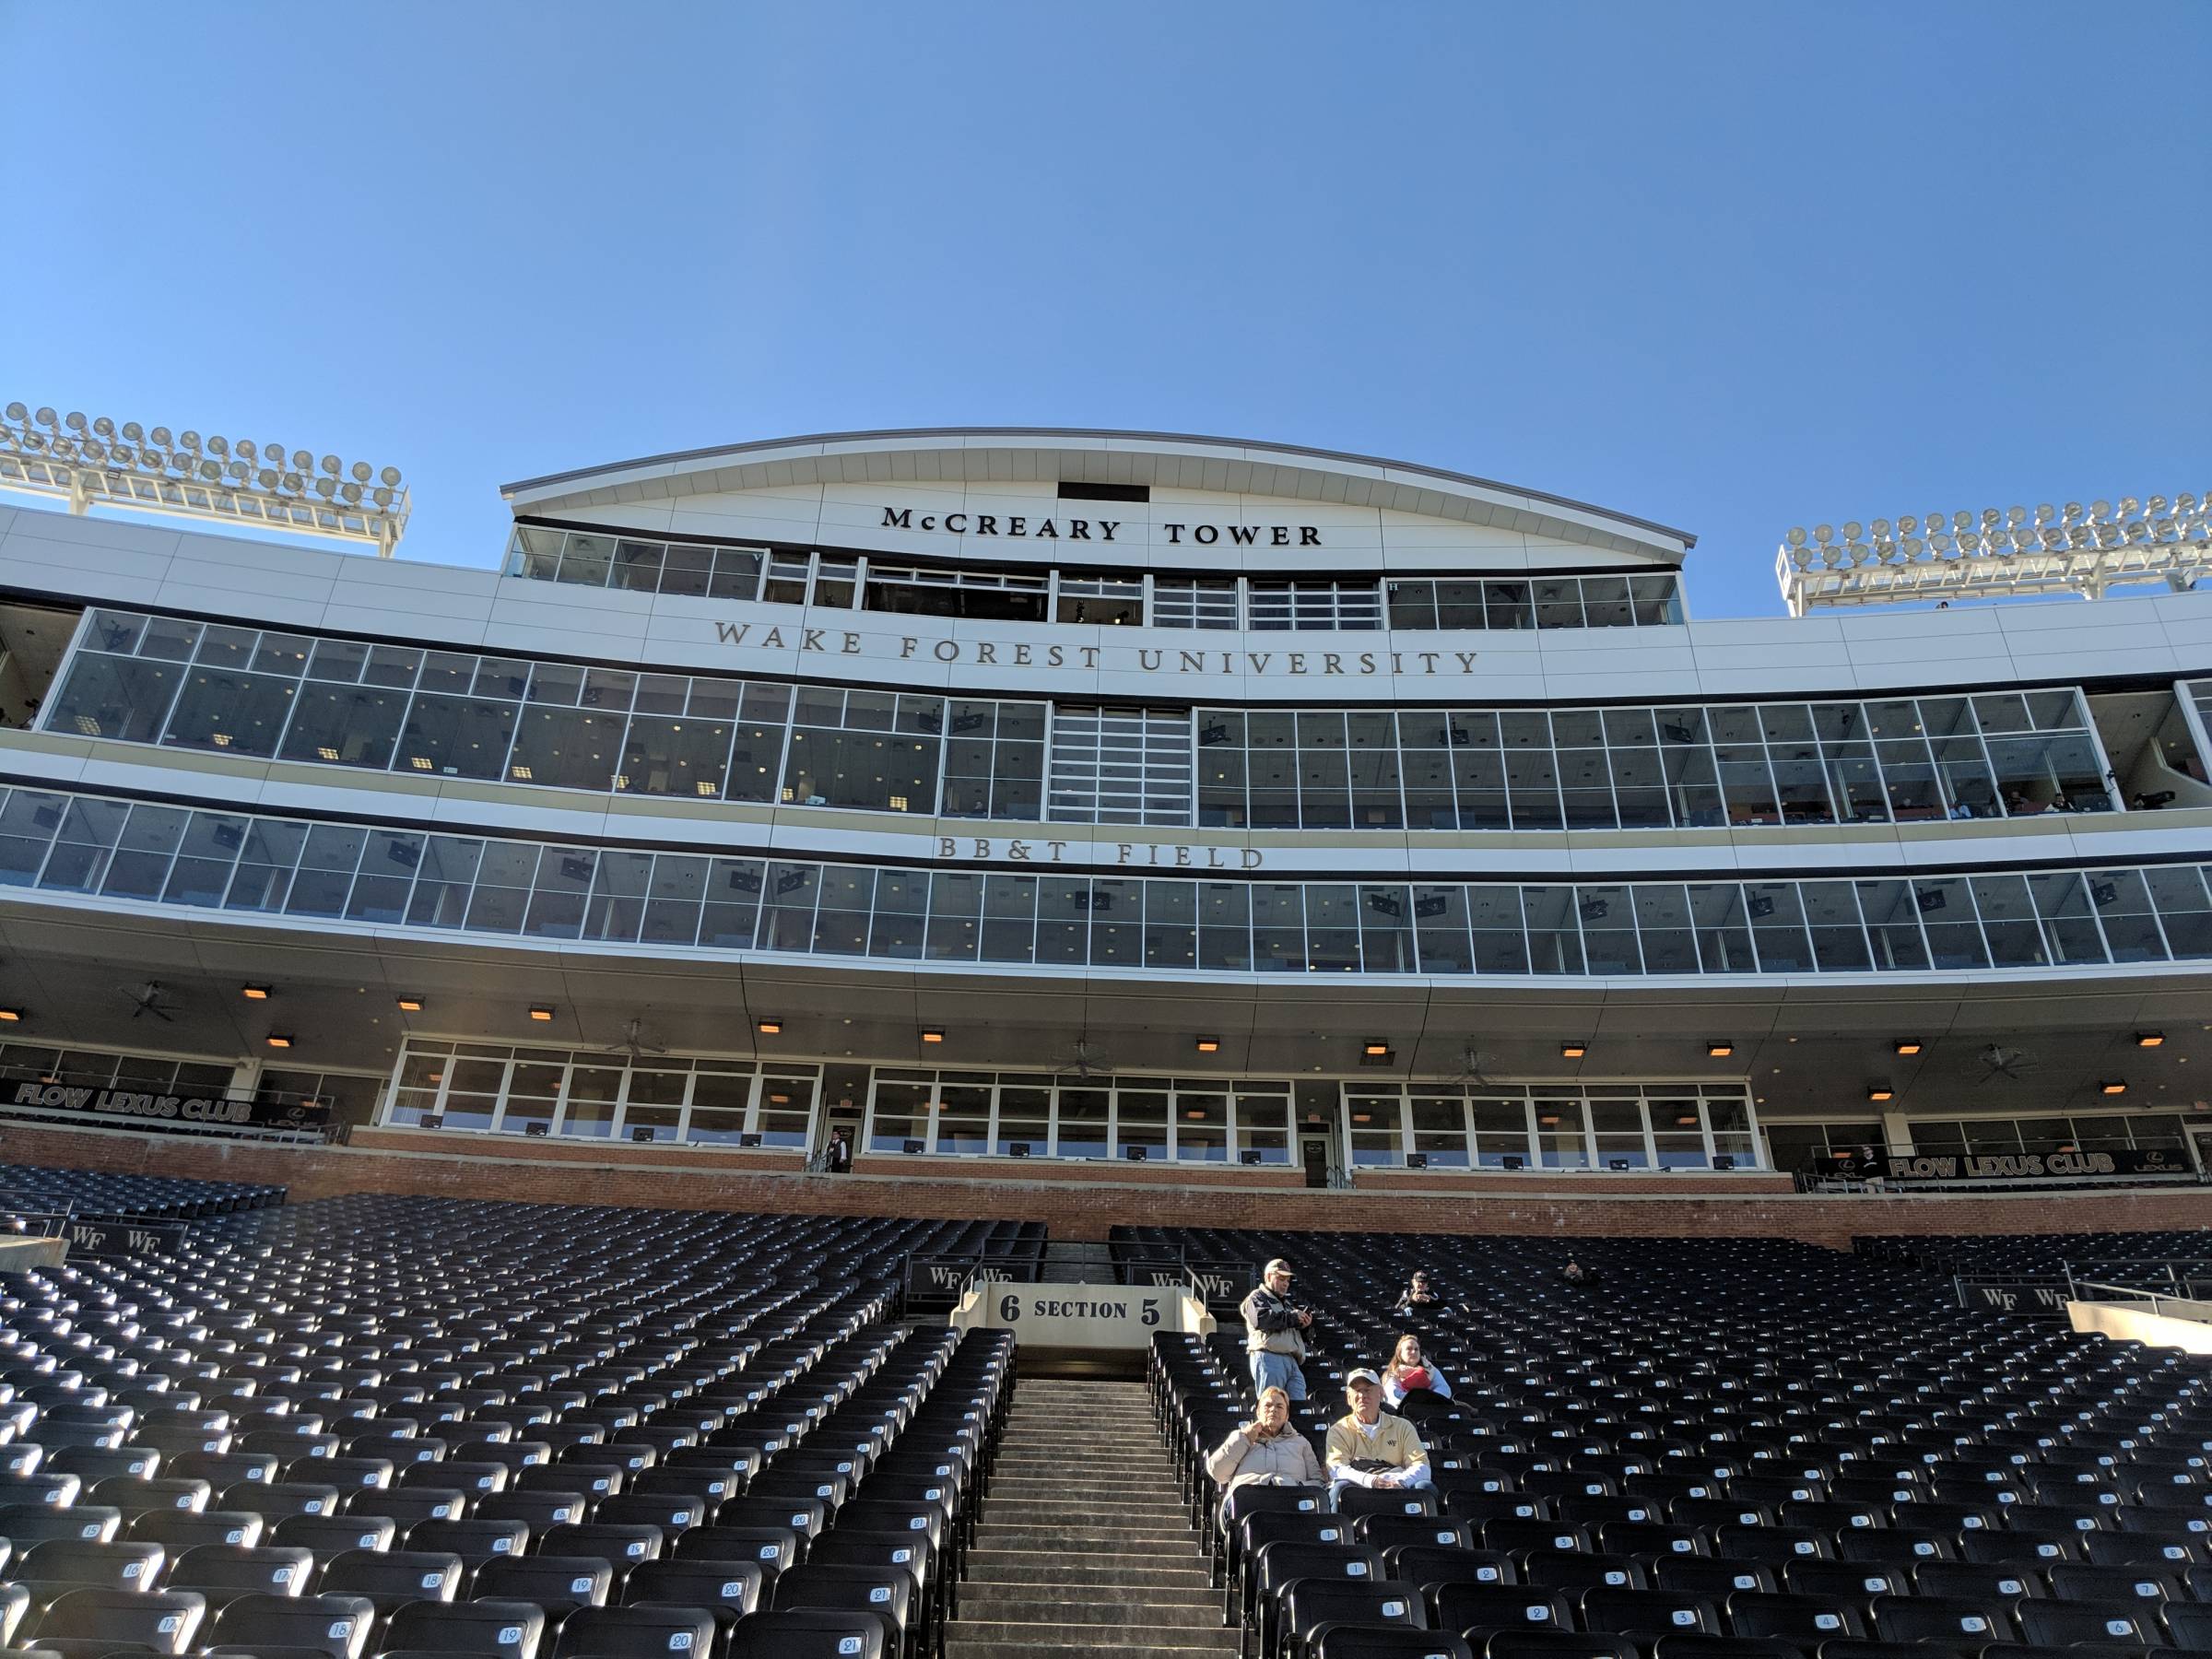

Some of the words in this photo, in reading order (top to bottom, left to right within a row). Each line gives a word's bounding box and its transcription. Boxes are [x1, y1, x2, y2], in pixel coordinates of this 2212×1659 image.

[881, 506, 1122, 542] McCREARY
[1164, 523, 1324, 546] TOWER
[714, 621, 862, 654] WAKE
[900, 636, 1102, 669] FOREST
[1139, 649, 1479, 675] UNIVERSITY
[939, 837, 1067, 862] BB&T
[1117, 843, 1264, 869] FIELD
[15, 1083, 92, 1108] FLOW
[94, 1090, 181, 1117] LEXUS
[182, 1099, 253, 1123] CLUB
[1888, 1159, 1957, 1178] FLOW
[1963, 1155, 2044, 1176] LEXUS
[2047, 1153, 2116, 1173] CLUB
[74, 1225, 106, 1251] WF
[128, 1230, 161, 1254] WF
[930, 1266, 961, 1289] WF
[1202, 1275, 1233, 1298] WF
[1982, 1288, 2018, 1311] WF
[2034, 1288, 2070, 1311] WF
[1000, 1295, 1020, 1322] 6
[1034, 1300, 1127, 1319] SECTION
[1141, 1299, 1160, 1325] 5
[497, 1540, 507, 1549] 18
[631, 1544, 642, 1554] 19
[762, 1547, 776, 1557] 20
[896, 1551, 906, 1561] 21
[126, 1565, 139, 1575] 16
[277, 1570, 289, 1581] 17
[427, 1575, 438, 1586] 18
[576, 1580, 589, 1590] 19
[724, 1584, 739, 1595] 20
[874, 1589, 886, 1600] 21
[163, 1618, 177, 1630] 17
[334, 1624, 347, 1636] 18
[504, 1629, 517, 1641] 19
[672, 1635, 689, 1647] 20
[843, 1639, 856, 1651] 21
